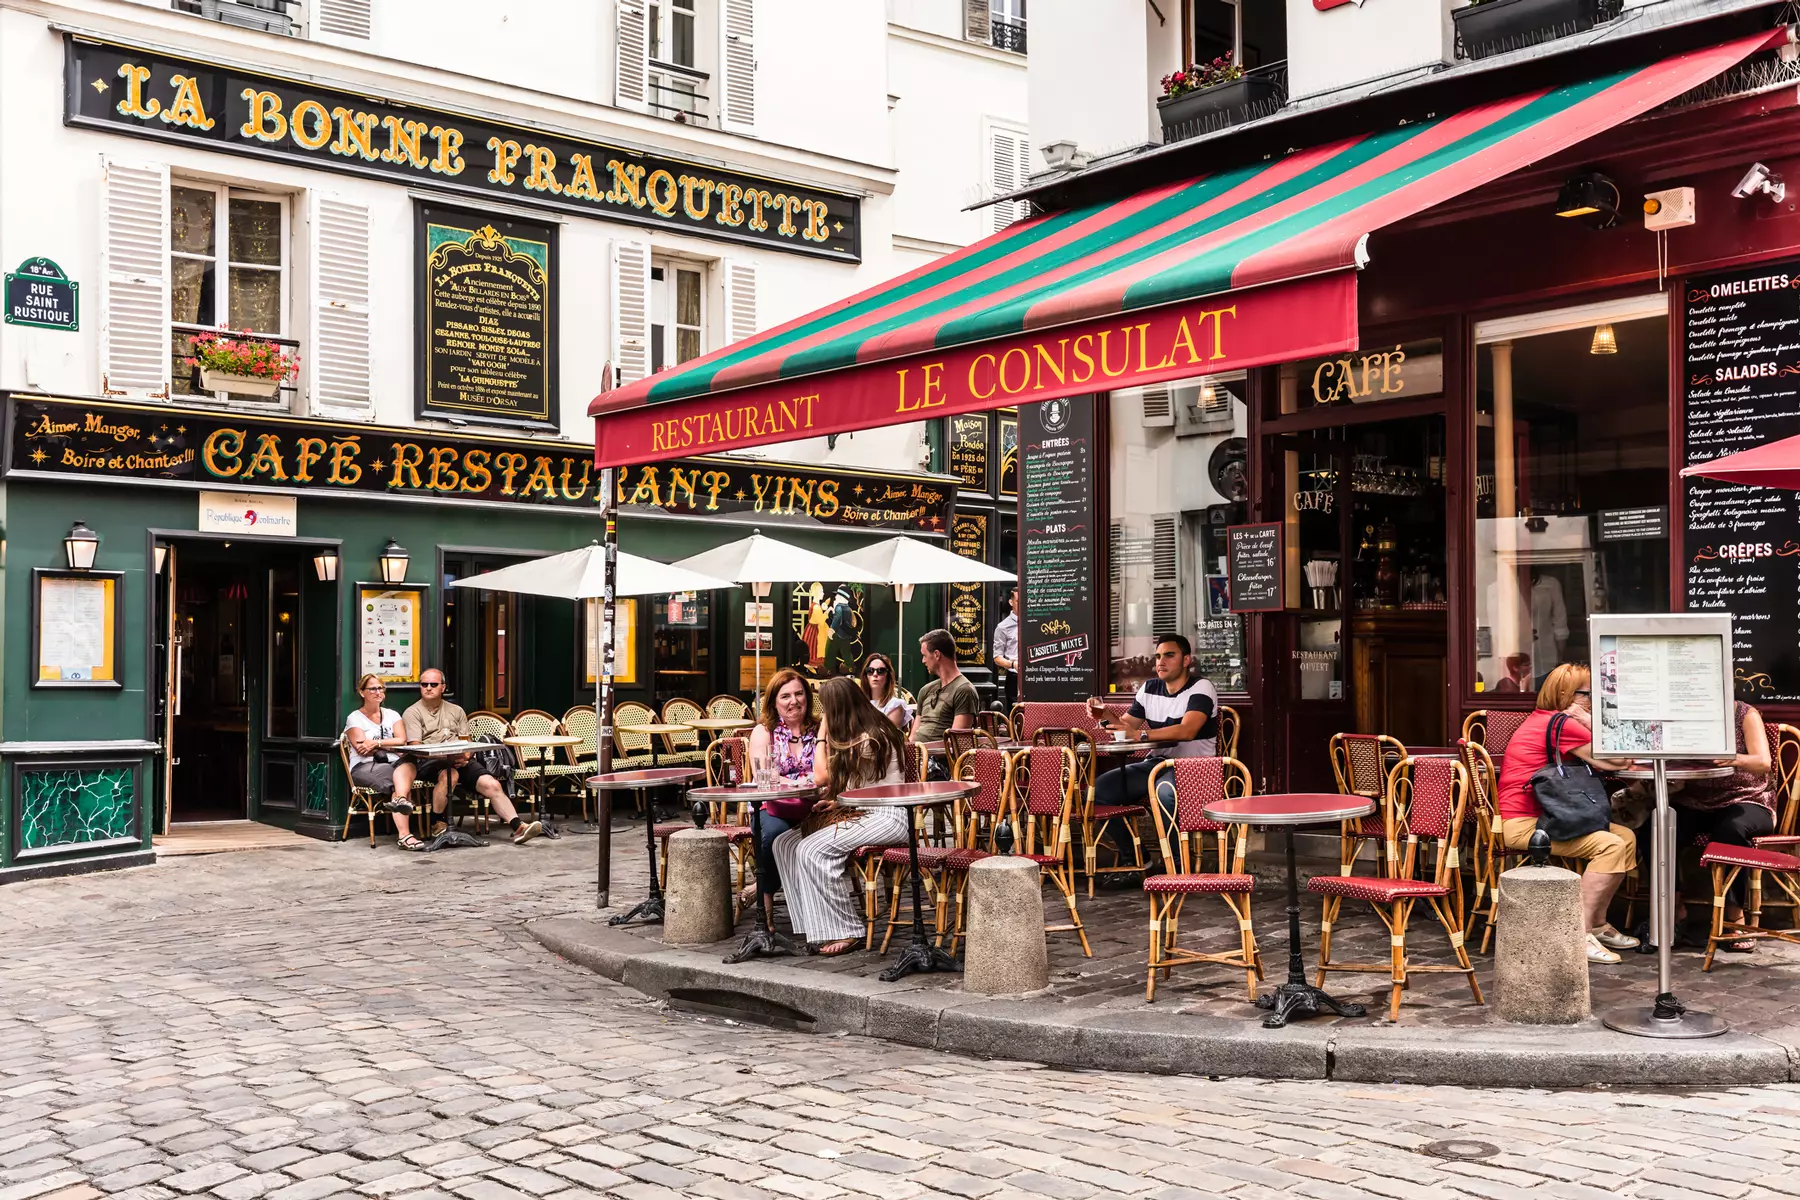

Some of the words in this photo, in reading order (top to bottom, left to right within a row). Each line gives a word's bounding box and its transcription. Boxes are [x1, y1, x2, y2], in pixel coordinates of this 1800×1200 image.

[116, 63, 215, 131] LA
[240, 88, 465, 176] BONNE
[486, 136, 831, 243] FRANQUETTE
[475, 252, 491, 261] Depuis
[435, 274, 451, 287] LA
[448, 263, 482, 277] BONNE
[483, 262, 541, 302] FRANQUETTE
[463, 276, 514, 292] Anciennement
[1710, 274, 1789, 298] OMELETTES
[31, 283, 53, 296] RUE
[468, 285, 500, 298] BILLARDS
[500, 291, 510, 299] EN
[25, 295, 59, 309] SAINT
[434, 289, 451, 299] Cette
[451, 293, 476, 303] auberge
[476, 295, 485, 303] est
[485, 296, 507, 306] célèbre
[507, 300, 528, 310] depuis
[528, 303, 541, 311] 1890
[14, 305, 70, 322] RUSTIQUE
[435, 299, 473, 312] Rendez-vous
[473, 304, 501, 316] d'artistes,
[501, 309, 512, 317] elle
[517, 311, 541, 321] accueilli
[1688, 305, 1717, 316] Omelette
[1718, 301, 1747, 313] complète
[479, 315, 499, 326] DIAZ
[1688, 316, 1717, 327] Omelette
[506, 330, 531, 338] DEGAS
[1688, 328, 1717, 338] Omelette
[1717, 325, 1747, 338] fromage
[1756, 318, 1799, 331] champignons
[471, 334, 541, 349] TOULOUSE-LAUTREC
[1688, 340, 1717, 350] Omelette
[1718, 336, 1761, 348] champignons
[434, 346, 448, 354] SON
[448, 348, 472, 357] JARDIN
[475, 352, 496, 360] SERVIT
[498, 354, 508, 362] DE
[509, 356, 536, 366] MODÈLE
[1688, 353, 1716, 362] Omelette
[1716, 351, 1742, 362] fromage
[450, 365, 466, 373] pour
[480, 368, 504, 377] tableau
[504, 371, 528, 380] célèbre
[651, 395, 820, 452] RESTAURANT
[895, 362, 947, 414] LE
[968, 305, 1237, 400] CONSULAT
[1311, 344, 1406, 403] CAFÉ
[1715, 362, 1778, 382] SALADES
[437, 381, 450, 389] Peint
[491, 387, 507, 396] exposé
[507, 390, 533, 399] maintenant
[1688, 389, 1712, 399] Salade
[1724, 385, 1752, 395] Consulat
[459, 391, 486, 403] MUSÉE
[486, 395, 518, 407] D'ORSAY
[1688, 410, 1711, 420] Salade
[1713, 407, 1754, 420] végétarienne
[25, 413, 82, 437] Aimer,
[85, 412, 141, 442] Manger,
[953, 419, 983, 434] Maison
[1688, 428, 1713, 439] Salade
[1715, 428, 1725, 436] de
[1727, 424, 1753, 435] volaille
[952, 433, 984, 451] Fondée
[1041, 437, 1070, 449] ENTRÉES
[60, 447, 106, 468] Boire
[108, 455, 125, 469] et
[951, 451, 960, 460] En
[961, 453, 976, 462] 1925
[976, 454, 985, 463] de
[1688, 451, 1713, 460] Salade
[201, 428, 363, 487] CAFÉ
[750, 473, 840, 518] VINS
[960, 462, 977, 474] PÈRE
[961, 475, 976, 485] FILS
[910, 483, 944, 504] Manger,
[1689, 486, 1712, 499] Croque
[1689, 499, 1712, 511] Croque
[842, 505, 869, 520] Boire
[870, 510, 881, 521] et
[1688, 509, 1722, 522] Spaghetti
[1723, 507, 1758, 519] bolognaise
[1760, 506, 1787, 514] maison
[1045, 524, 1066, 534] PLATS
[1688, 521, 1717, 530] Assiette
[1718, 521, 1727, 529] de
[1727, 520, 1734, 528] 3
[1733, 520, 1766, 532] fromages
[1233, 532, 1243, 540] LES
[1244, 531, 1249, 539] +
[1259, 529, 1276, 538] CARTE
[1236, 541, 1251, 551] Pièce
[1719, 542, 1773, 559] CRÊPES
[1688, 565, 1700, 574] Au
[1696, 576, 1705, 584] la
[1706, 576, 1735, 587] confiture
[1746, 575, 1765, 586] fraise
[1707, 587, 1736, 599] confiture
[1737, 586, 1767, 594] d'abricot
[1688, 600, 1700, 608] Au
[1702, 600, 1726, 608] Nutella
[1197, 621, 1207, 629] LES
[1207, 619, 1223, 630] PÂTES
[1733, 626, 1752, 635] rhum
[1029, 643, 1059, 658] L'ASSIETTE
[1061, 637, 1083, 651] MIXTE
[1291, 650, 1338, 660] RESTAURANT
[1300, 662, 1329, 671] OUVERT
